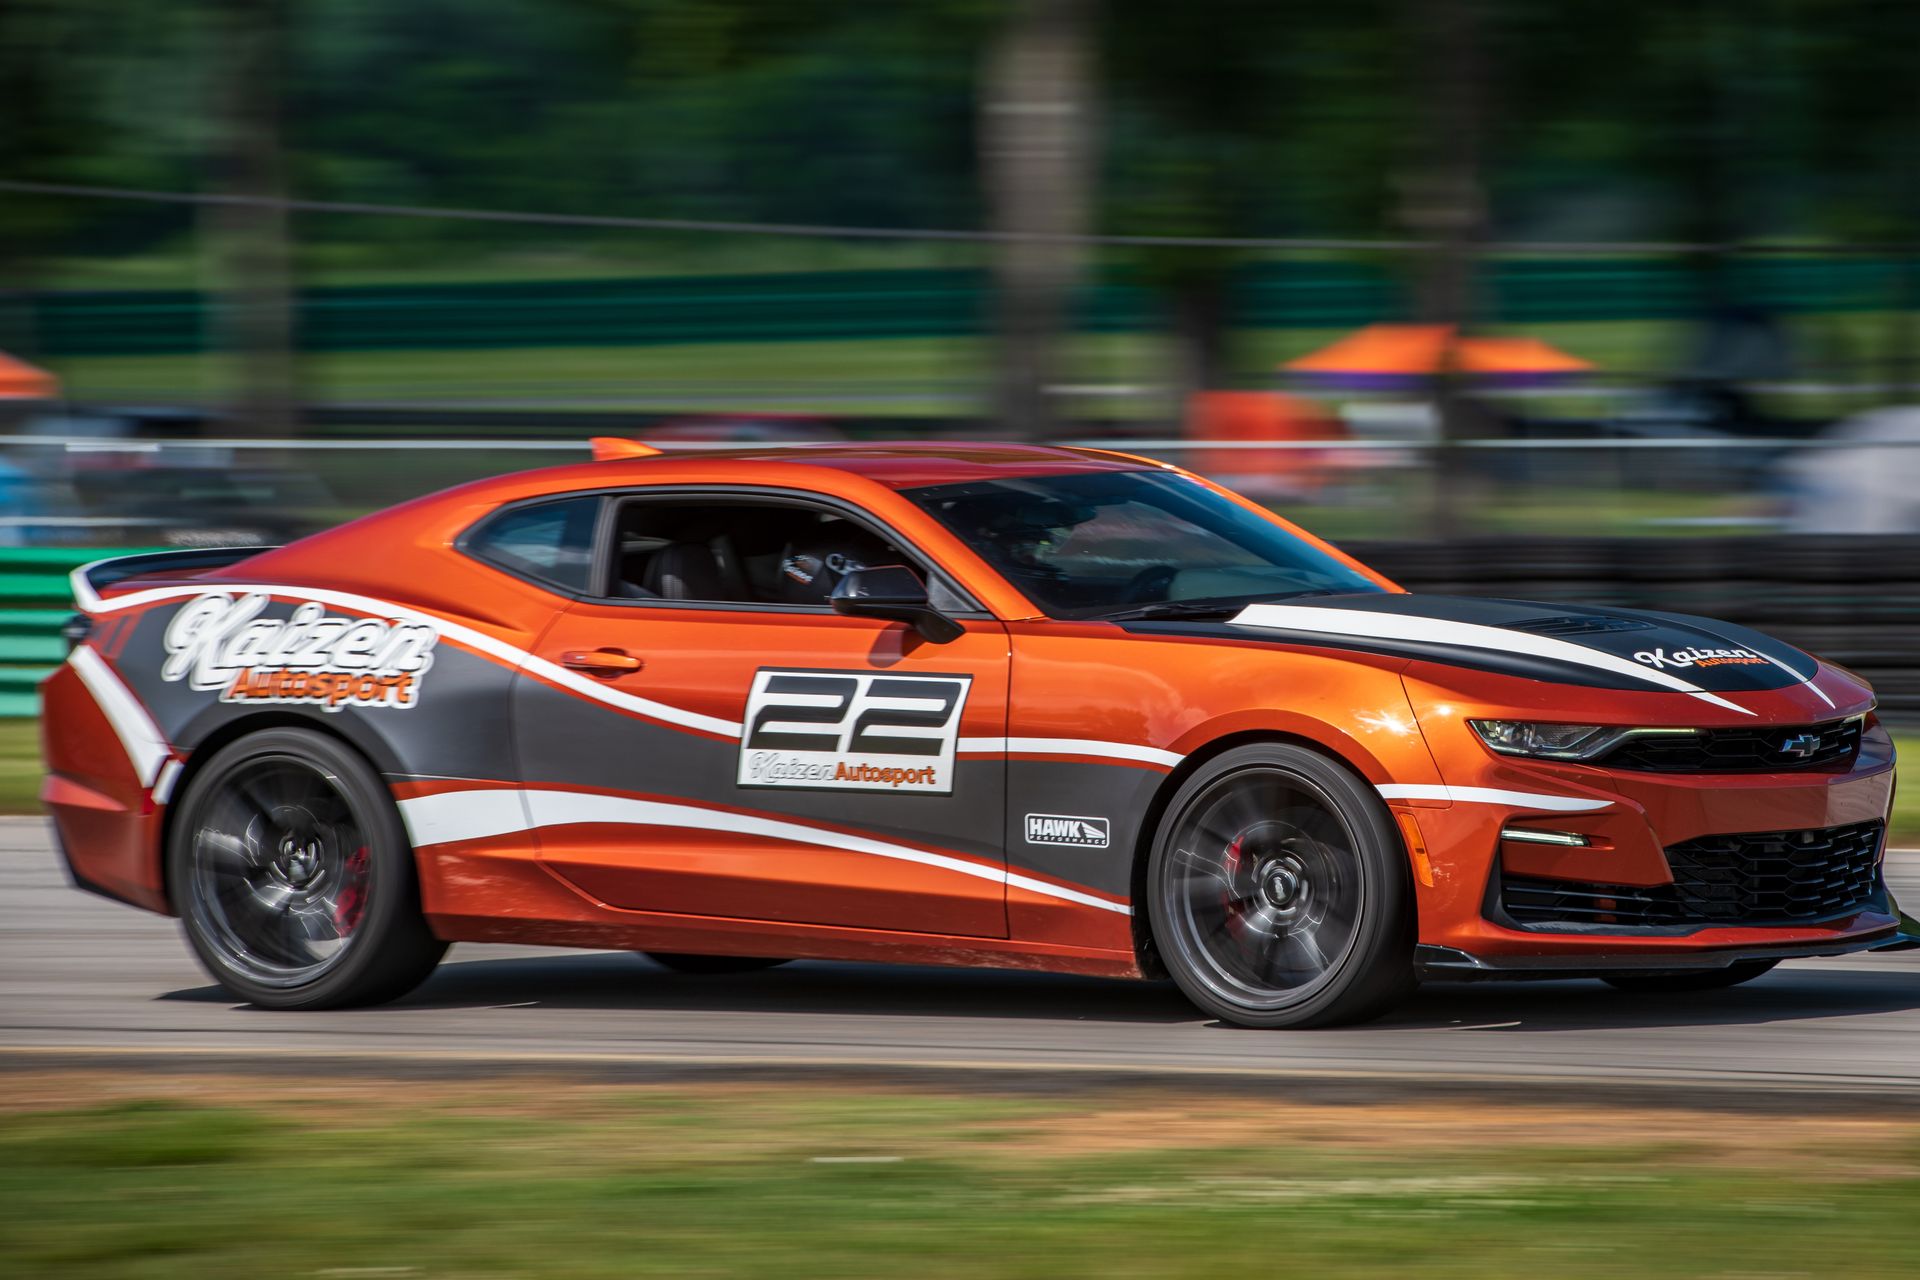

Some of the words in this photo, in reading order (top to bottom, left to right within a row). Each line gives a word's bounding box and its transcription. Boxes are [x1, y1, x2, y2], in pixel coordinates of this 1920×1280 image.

[162, 592, 438, 690] Kaizen
[1633, 646, 1757, 668] Kaizen
[224, 667, 416, 710] Autosport
[747, 675, 961, 756] 22
[835, 762, 936, 787] Autosport
[1029, 818, 1081, 837] HAWK
[1029, 835, 1106, 845] PERFORMANCE
